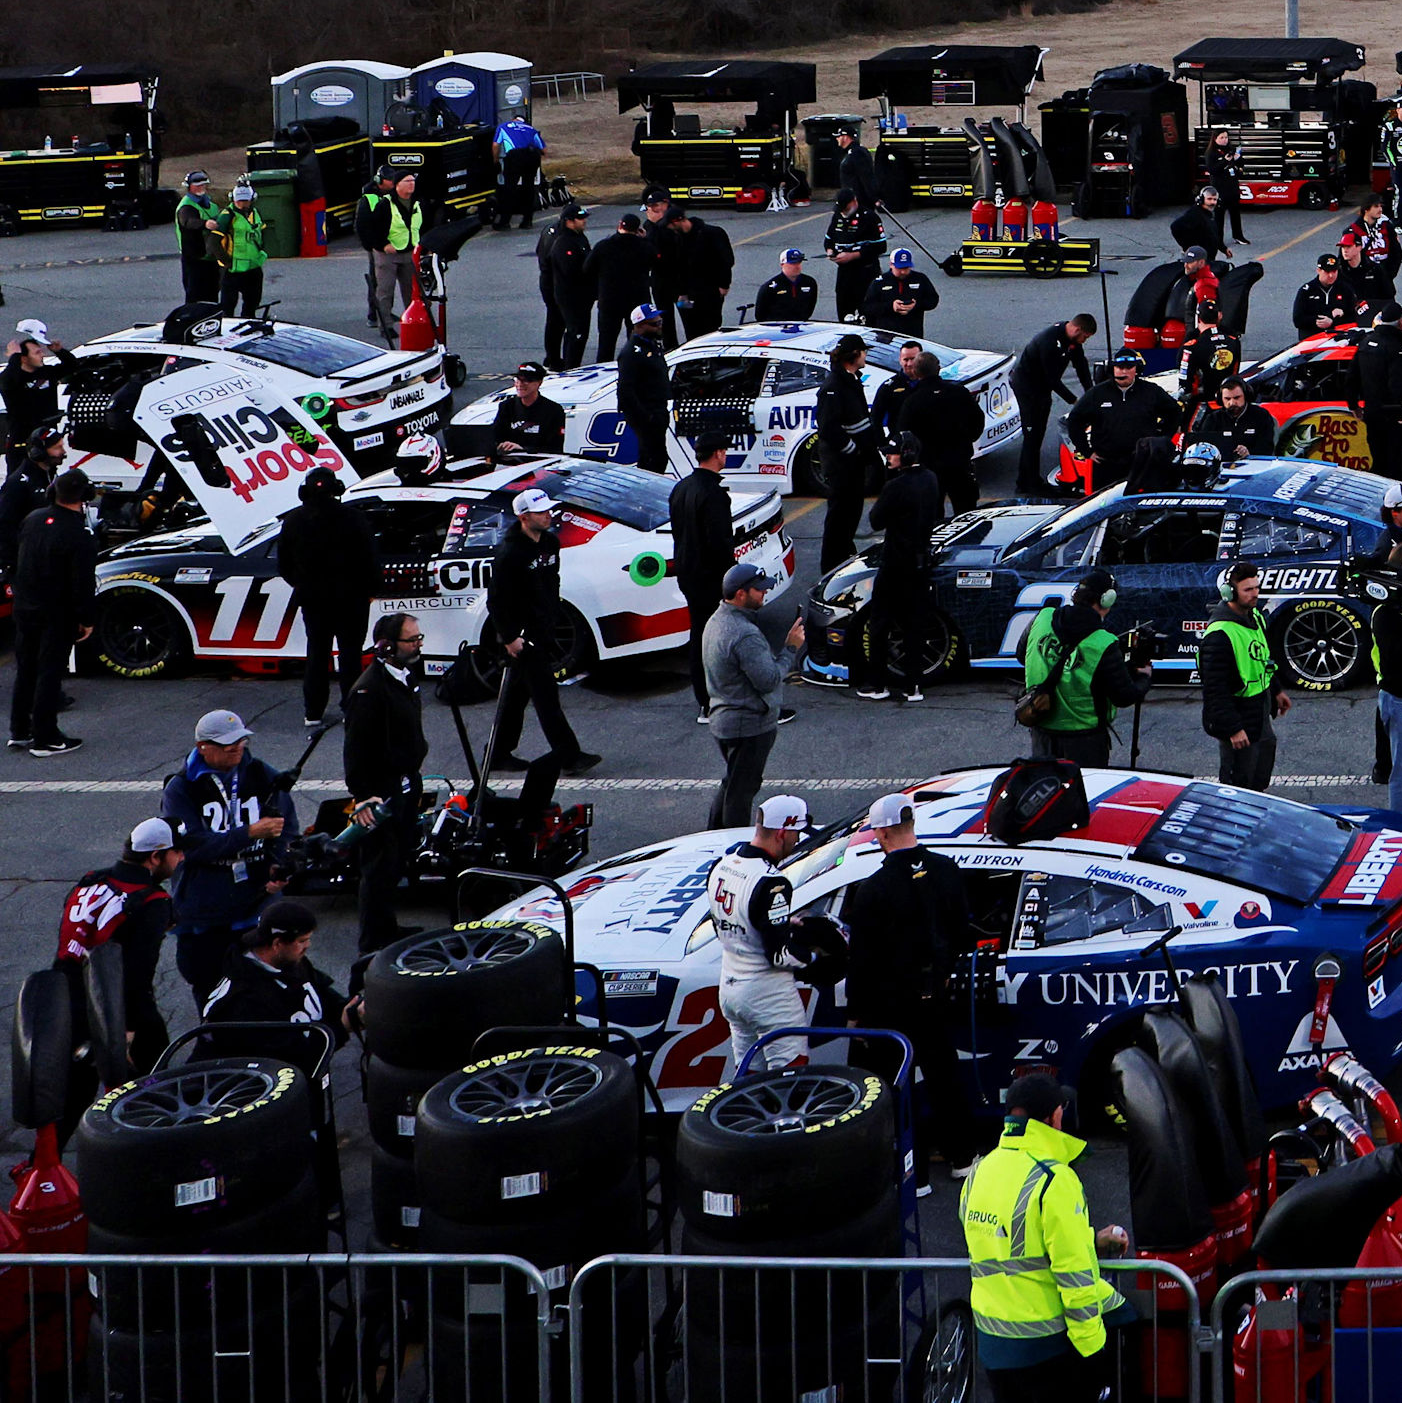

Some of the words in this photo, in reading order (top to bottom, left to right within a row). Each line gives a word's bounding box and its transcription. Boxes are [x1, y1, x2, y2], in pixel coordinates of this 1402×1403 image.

[1328, 131, 1337, 150] 3
[1238, 185, 1254, 200] 3
[1267, 185, 1289, 193] RCR
[1006, 247, 1016, 257] 7
[193, 319, 220, 338] Arai
[405, 412, 440, 434] TOYOTA
[1318, 415, 1358, 436] Bass
[580, 409, 638, 458] 9
[763, 448, 786, 460] prime
[1321, 436, 1350, 453] Pro
[1321, 451, 1371, 472] Shops
[1138, 498, 1180, 507] AUSTIN
[1180, 498, 1229, 507] CINDRIC
[1292, 506, 1349, 528] Snap-on
[209, 575, 296, 642] 11
[383, 596, 477, 611] HAIRCUTS
[1294, 600, 1362, 631] GOODYEAR
[944, 634, 959, 669] EAGLE
[1177, 643, 1200, 653] Auto
[98, 653, 165, 679] GOODYEAR
[1296, 678, 1333, 692] EAGLE
[1018, 779, 1058, 815] BELL
[972, 854, 1024, 867] BYRON
[453, 919, 555, 940] GOODYEAR
[1182, 919, 1220, 931] Valvoline
[620, 971, 651, 981] NASCAR
[608, 983, 624, 993] CUP
[624, 982, 651, 992] SERIES
[1015, 1038, 1045, 1060] Z
[1045, 1038, 1059, 1054] hp
[462, 1045, 602, 1074] GOODYEAR
[91, 1080, 138, 1112] EAGLE
[202, 1067, 297, 1126] GOODYEAR
[690, 1082, 734, 1113] EAGLE
[804, 1075, 883, 1134] GOODYEAR
[39, 1181, 57, 1194] 3
[27, 1220, 66, 1234] Garage
